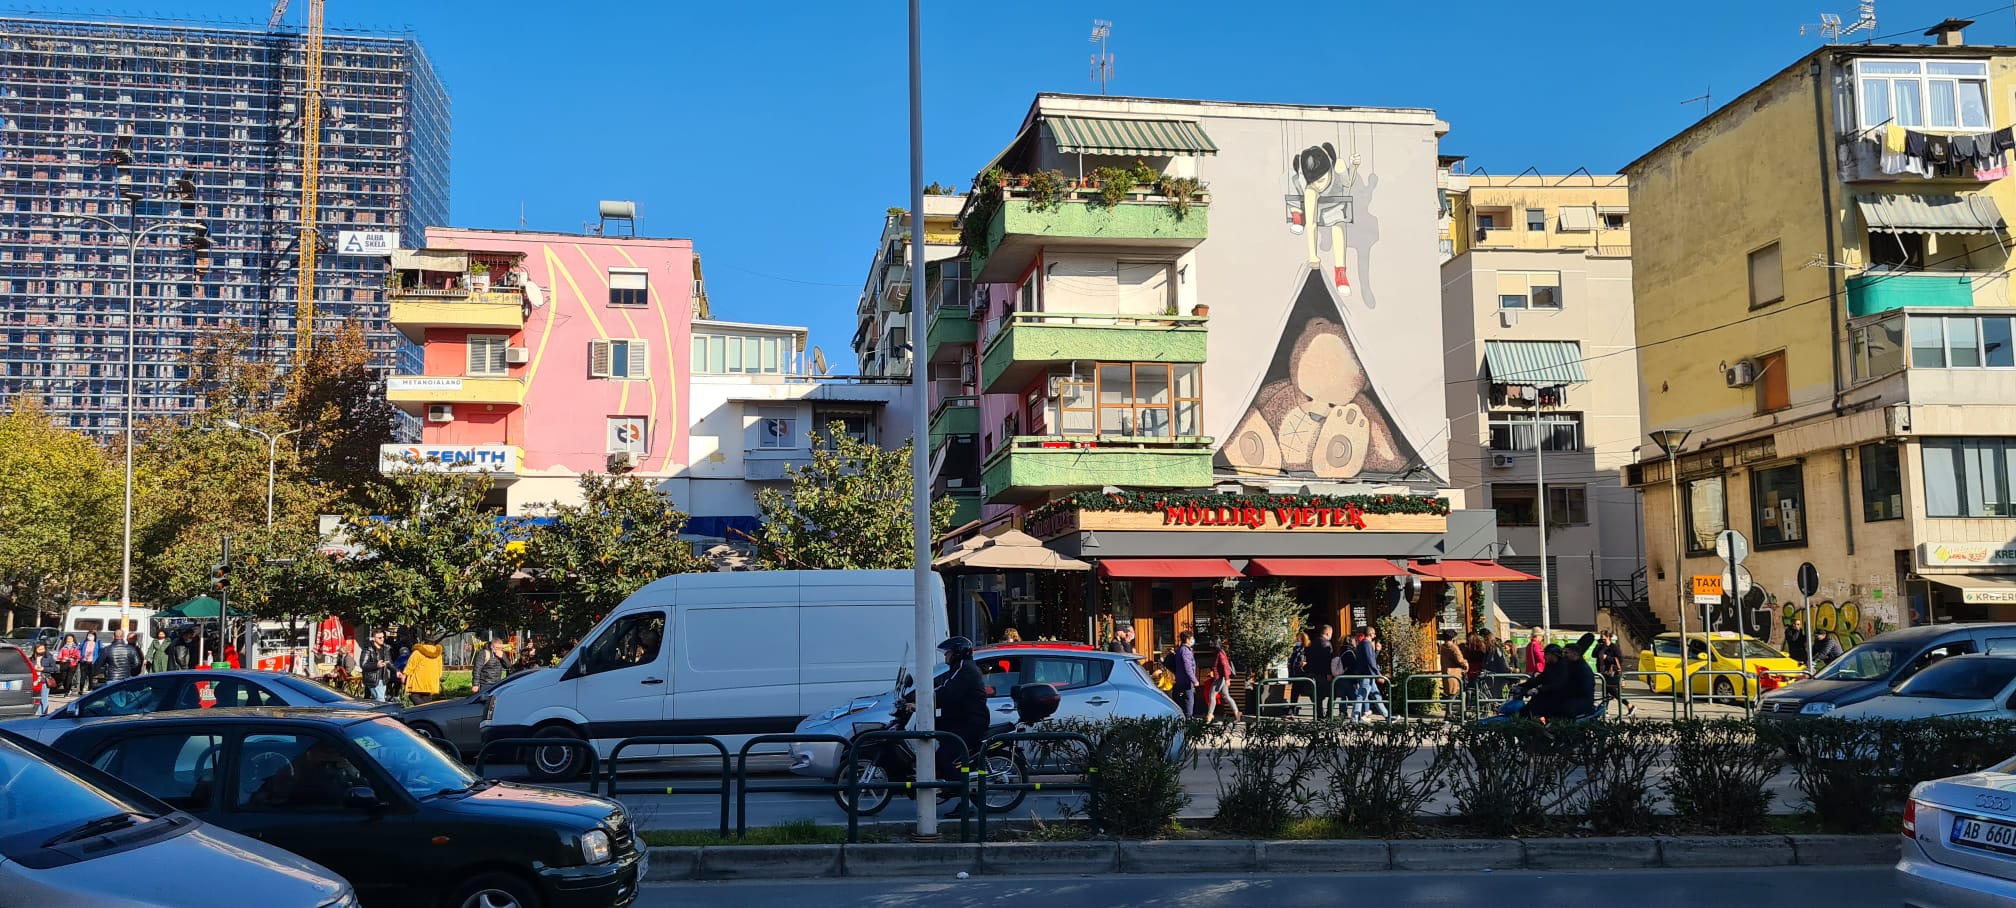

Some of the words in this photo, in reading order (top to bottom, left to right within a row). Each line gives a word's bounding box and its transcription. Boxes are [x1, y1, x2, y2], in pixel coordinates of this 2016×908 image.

[365, 240, 386, 248] SKELA
[1165, 506, 1267, 528] MULLIRI
[1995, 550, 2016, 559] KRE
[1695, 578, 1721, 587] TAXI
[1963, 821, 1981, 839] AB
